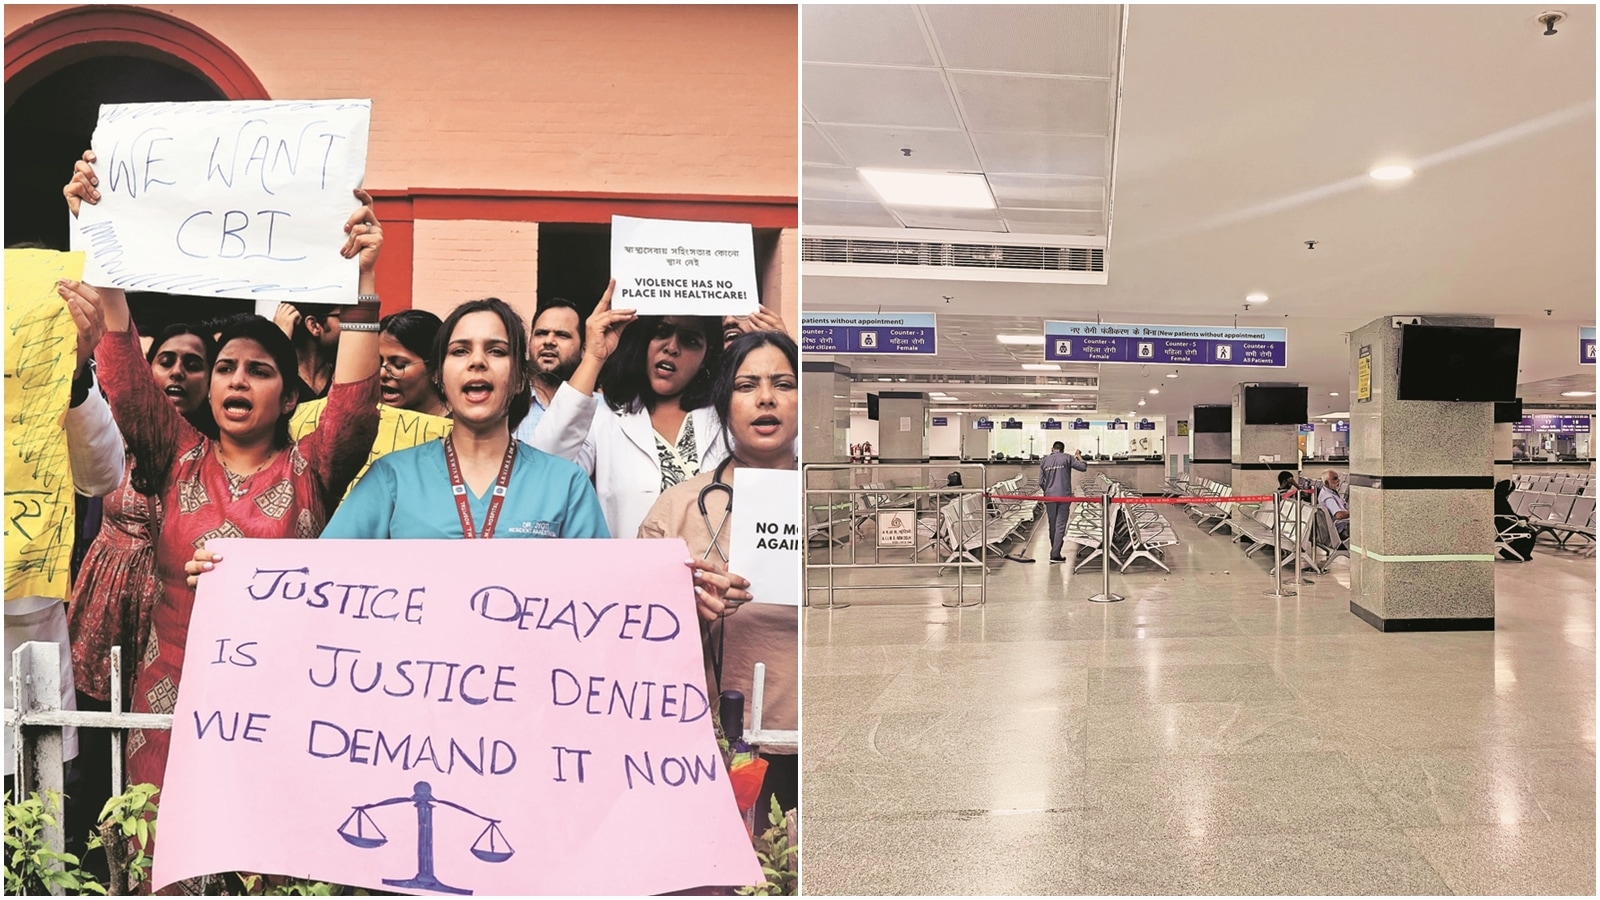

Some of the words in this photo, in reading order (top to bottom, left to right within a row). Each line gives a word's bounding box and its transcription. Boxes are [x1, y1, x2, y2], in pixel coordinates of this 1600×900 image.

[109, 127, 176, 199] WE
[207, 119, 345, 195] WANT
[176, 210, 307, 261] CBI
[714, 249, 739, 257] কোনো
[685, 258, 700, 266] নেই
[634, 278, 688, 288] VIOLENCE
[691, 279, 713, 289] HAS
[716, 280, 733, 289] NO
[622, 289, 656, 298] PLACE
[659, 290, 671, 298] IN
[674, 290, 747, 300] HEALTHCARE!
[1084, 326, 1097, 335] रोगी
[1101, 327, 1129, 335] पंजीकरण
[1133, 327, 1140, 336] के
[1143, 328, 1156, 336] बिना
[1224, 332, 1265, 340] appointment)
[819, 336, 833, 344] रोगी
[890, 337, 908, 345] महिला
[912, 337, 925, 345] रोगी
[1082, 346, 1100, 354] महिला
[1103, 346, 1116, 354] रोगी
[1164, 348, 1182, 356] महिला
[1185, 348, 1197, 356] रोगी
[1260, 350, 1272, 358] रोगी
[487, 501, 499, 526] HOSPITAL
[755, 522, 779, 534] NO
[783, 524, 798, 535] M
[245, 567, 426, 624] JUSTICE
[470, 585, 681, 643] DELAYED
[211, 638, 258, 667] IS
[309, 644, 517, 706] JUSTICE
[551, 668, 711, 723] DENIED
[193, 710, 271, 743] WE
[307, 720, 517, 776] DEMAND
[551, 746, 592, 783] IT
[624, 751, 716, 789] NOW
